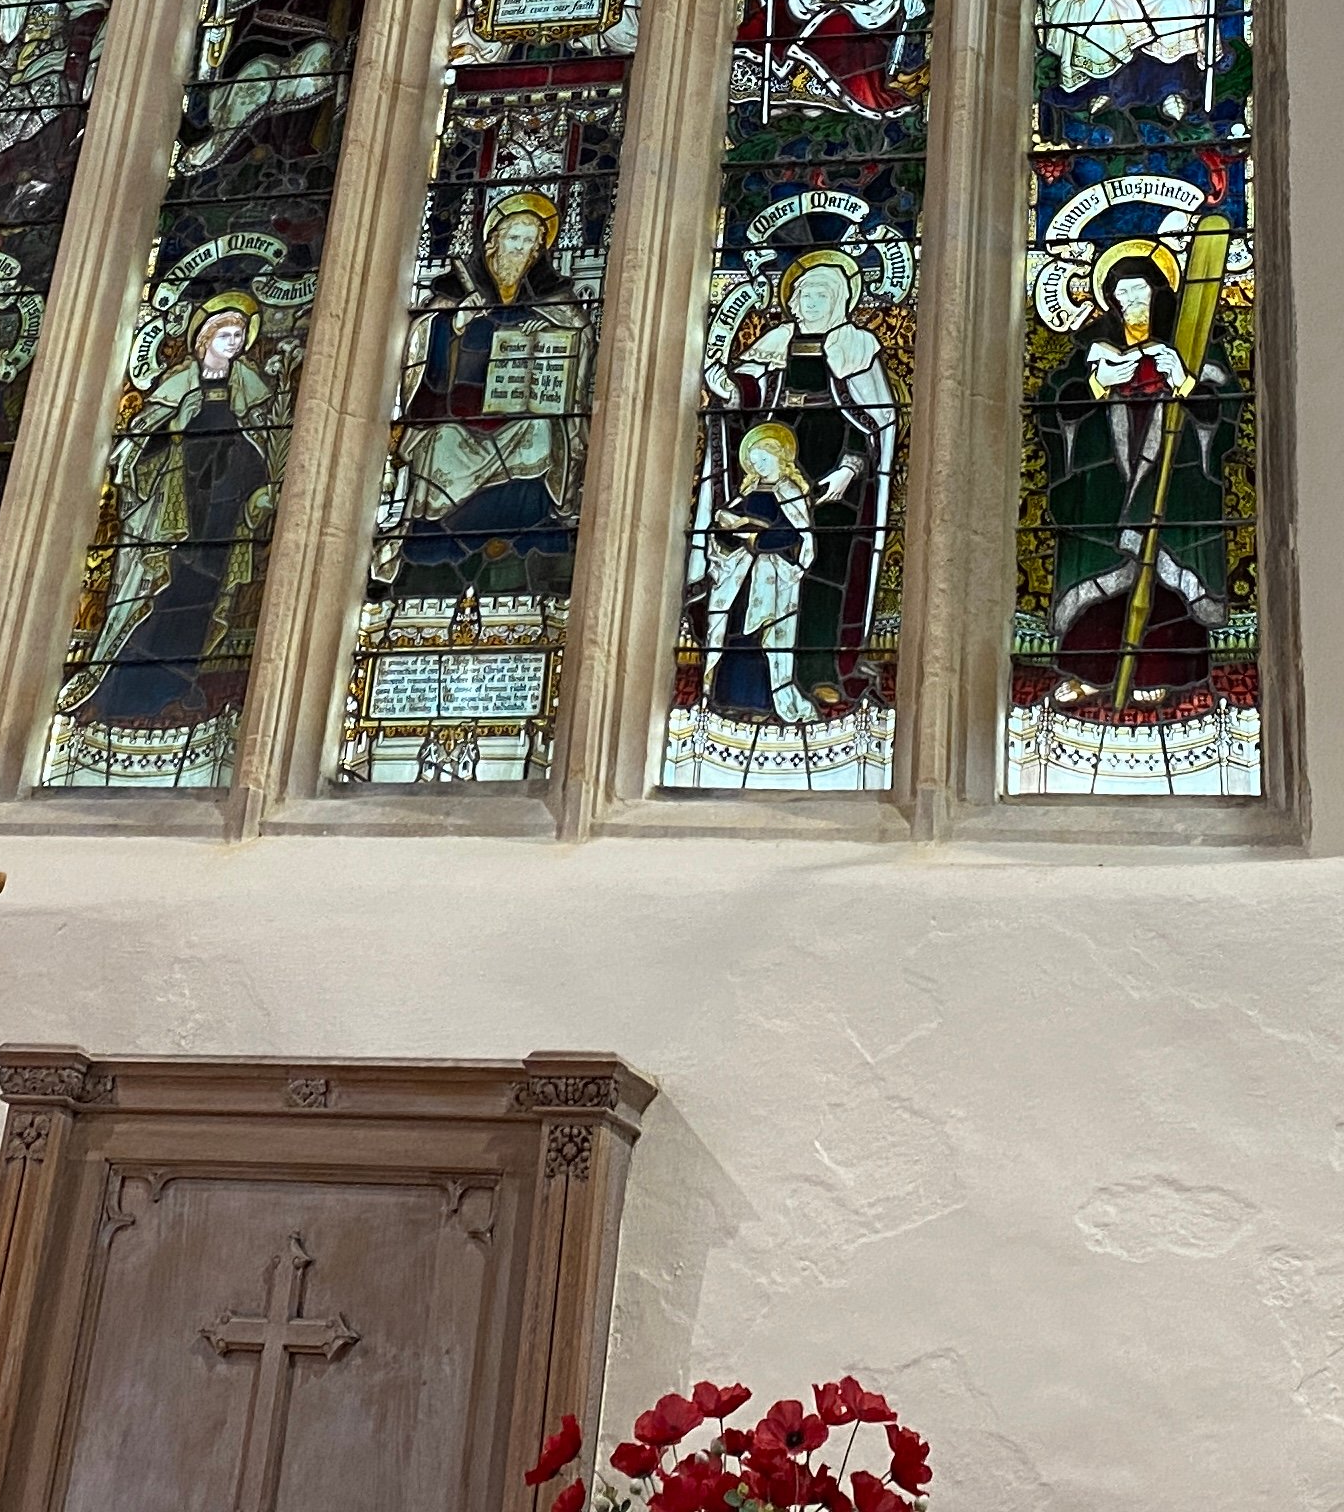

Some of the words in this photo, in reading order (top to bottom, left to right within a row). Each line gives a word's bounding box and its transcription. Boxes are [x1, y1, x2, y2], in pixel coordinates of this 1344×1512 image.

[552, 3, 569, 13] our
[570, 0, 595, 16] faith
[132, 324, 163, 379] Sancta
[227, 235, 274, 254] Mater
[719, 288, 752, 332] Anna
[753, 200, 796, 236] Mater
